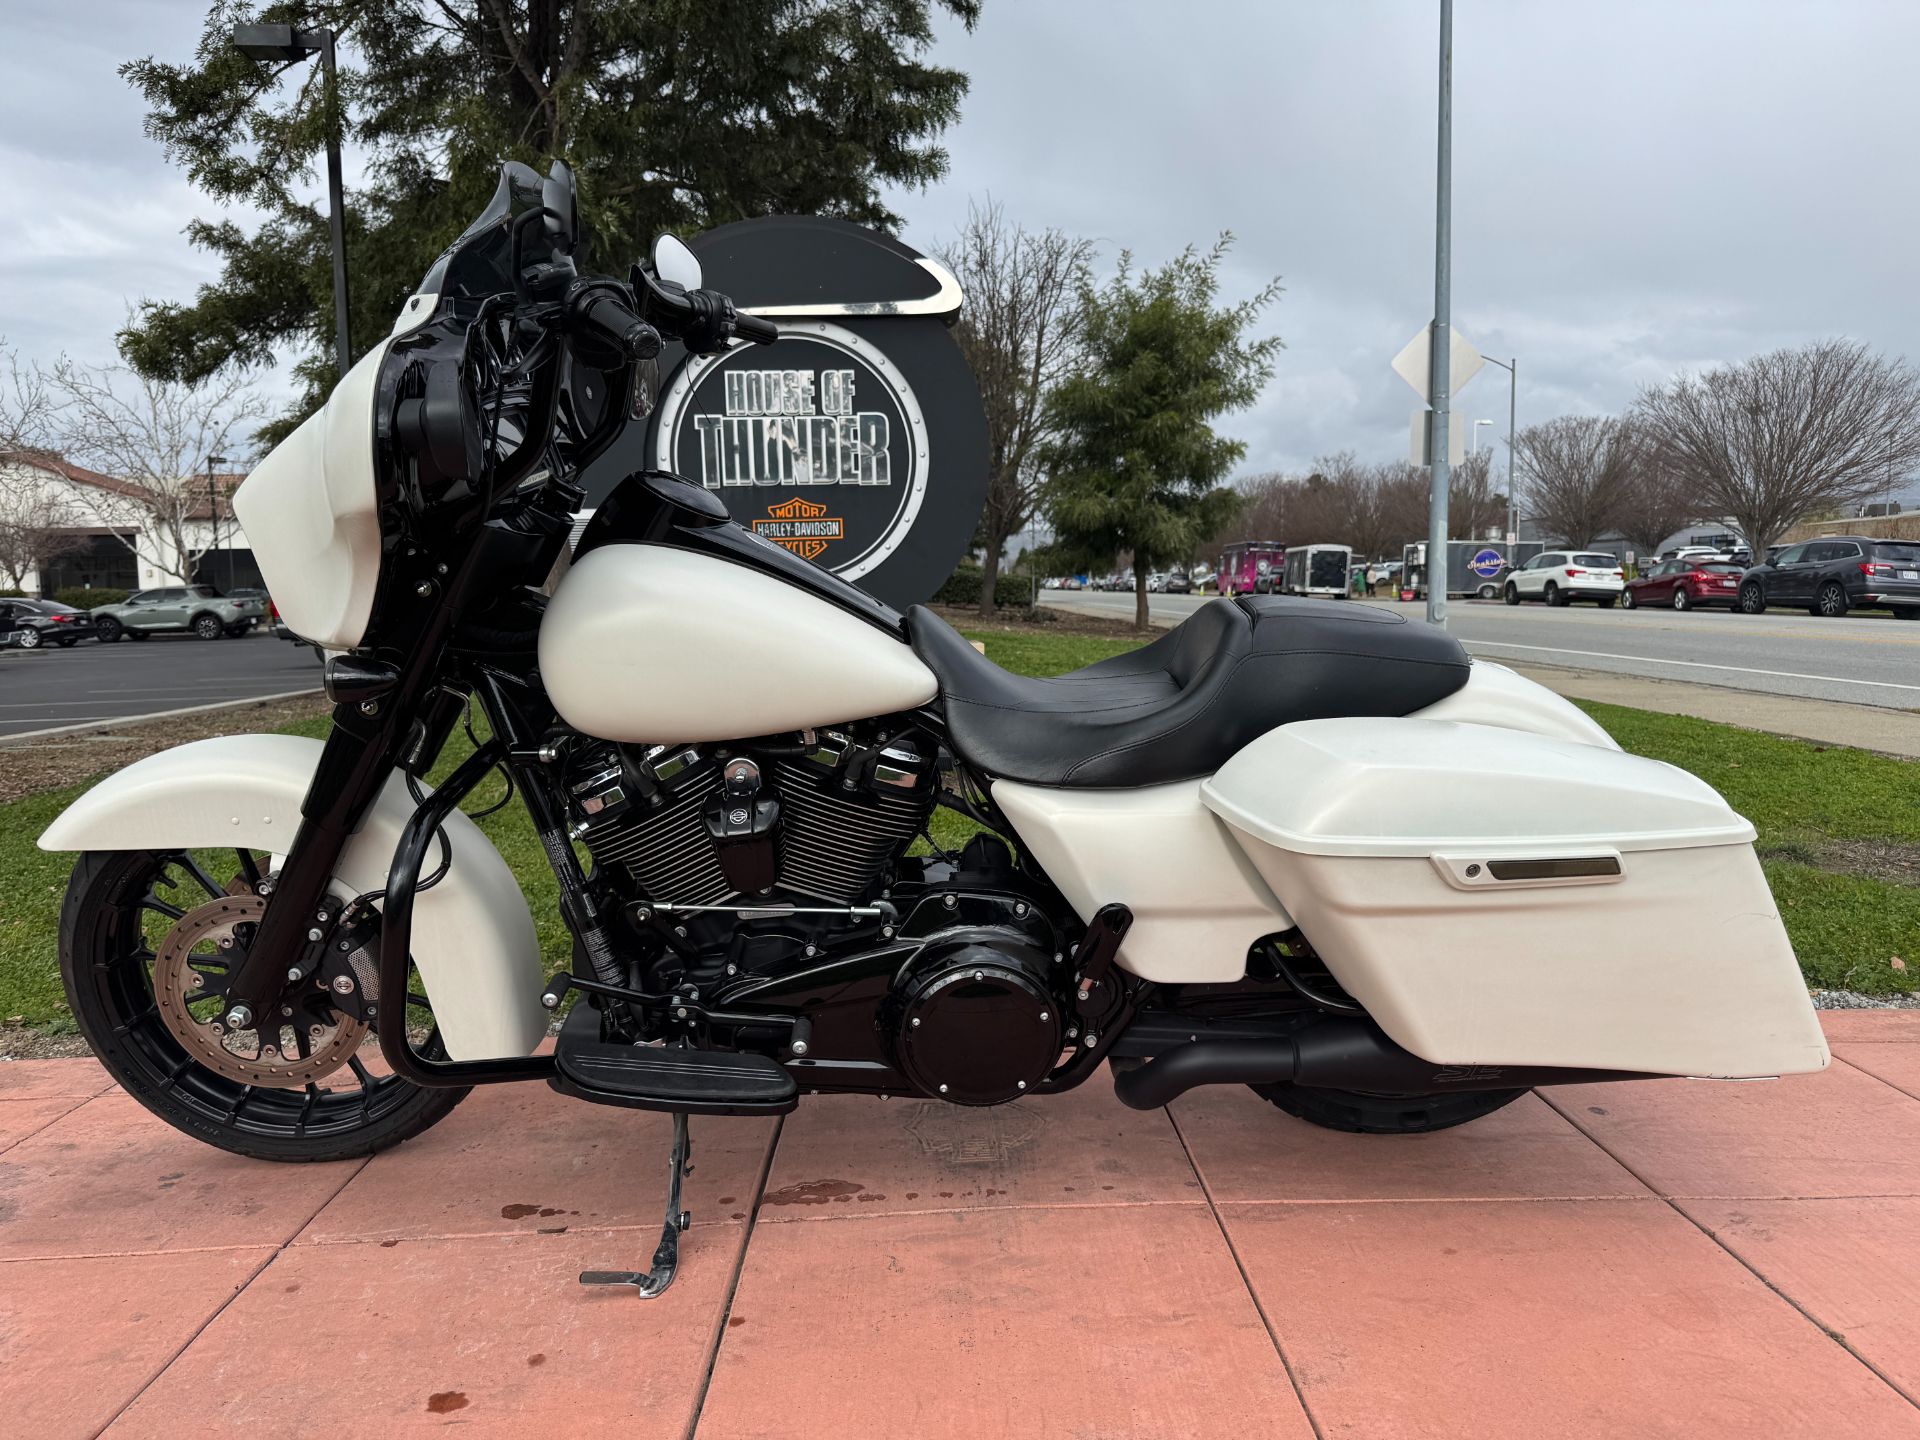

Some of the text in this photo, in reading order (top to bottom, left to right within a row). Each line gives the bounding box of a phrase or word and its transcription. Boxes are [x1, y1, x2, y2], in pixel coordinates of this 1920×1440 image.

[724, 369, 855, 416] HOUSE OF
[694, 412, 891, 489] THUNDER
[776, 501, 819, 517] MOTOR
[757, 520, 840, 537] HARLEY-DAVIDSON
[778, 540, 820, 557] YCLES
